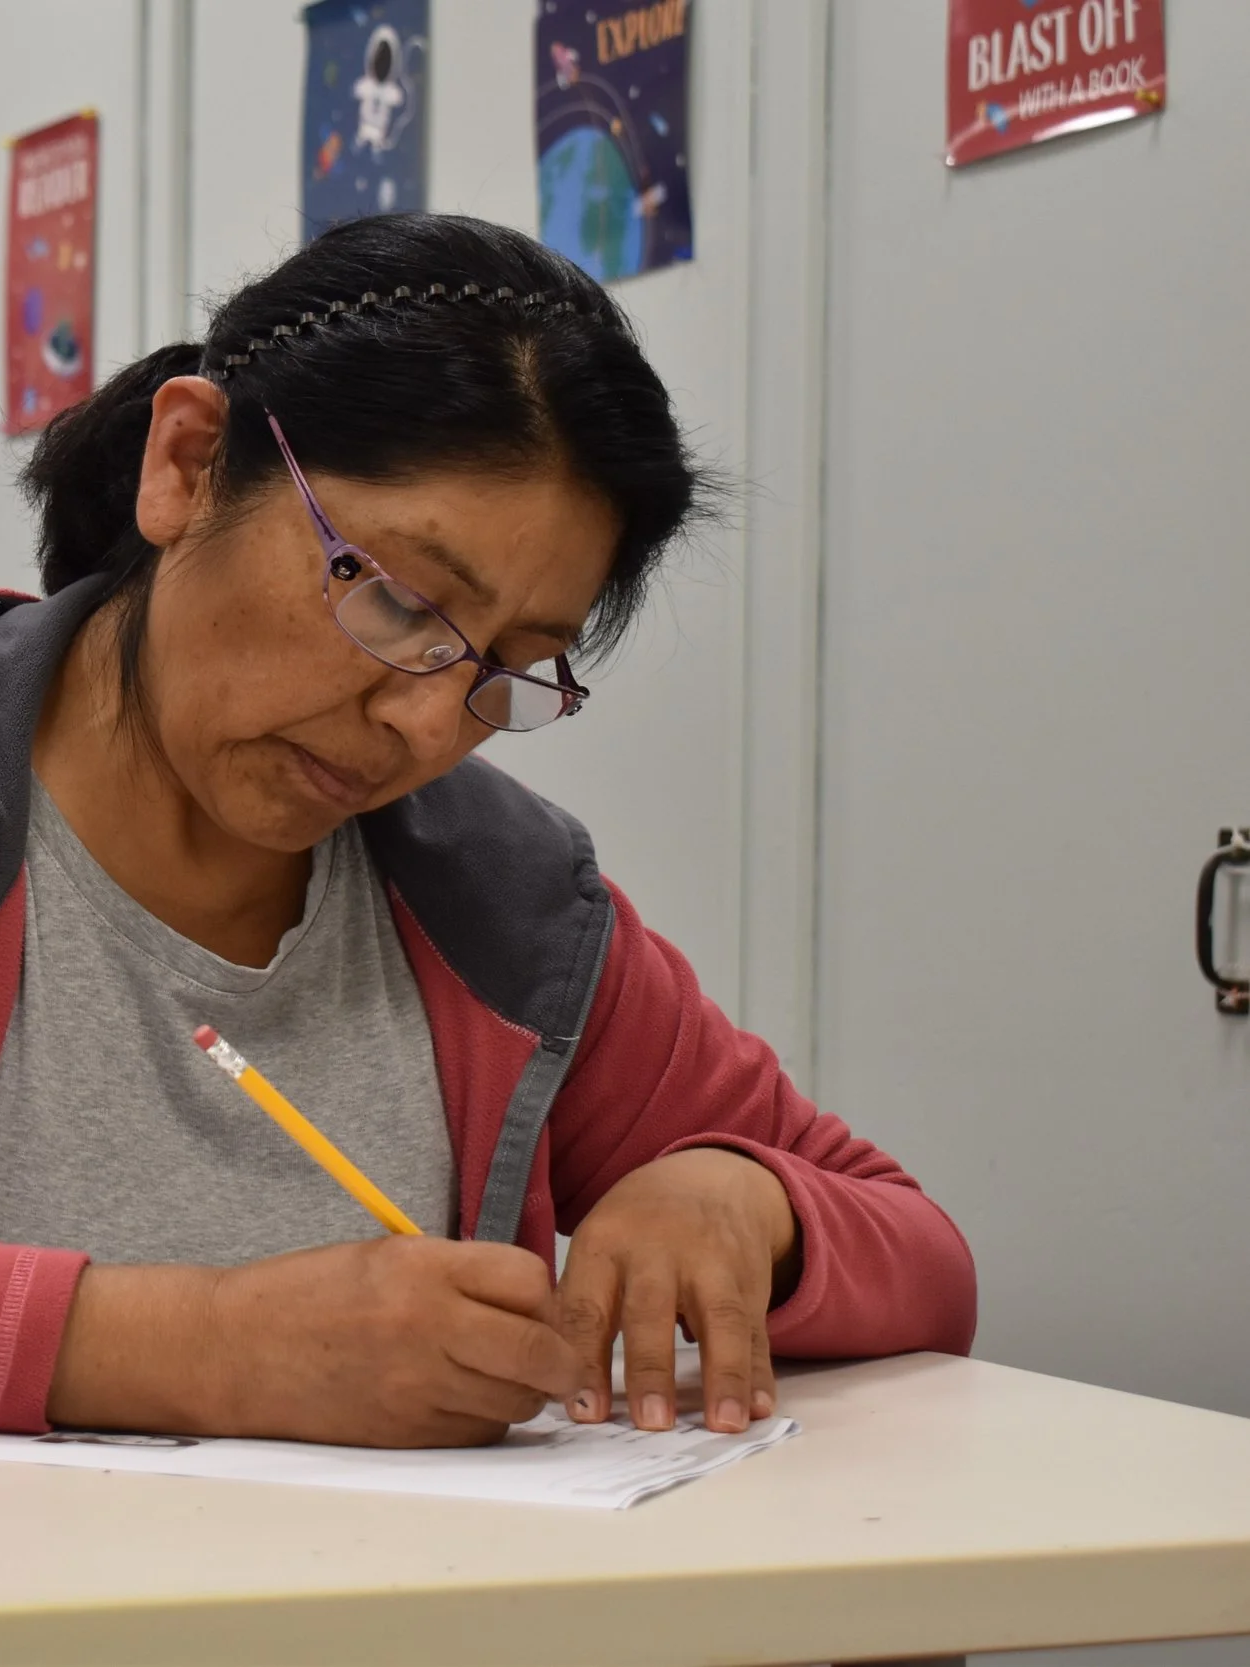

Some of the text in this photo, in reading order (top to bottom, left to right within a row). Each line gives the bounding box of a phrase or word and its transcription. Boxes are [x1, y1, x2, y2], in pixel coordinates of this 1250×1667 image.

[968, 0, 1142, 92] BLAST OFF
[1018, 54, 1147, 121] WITH A BOOK
